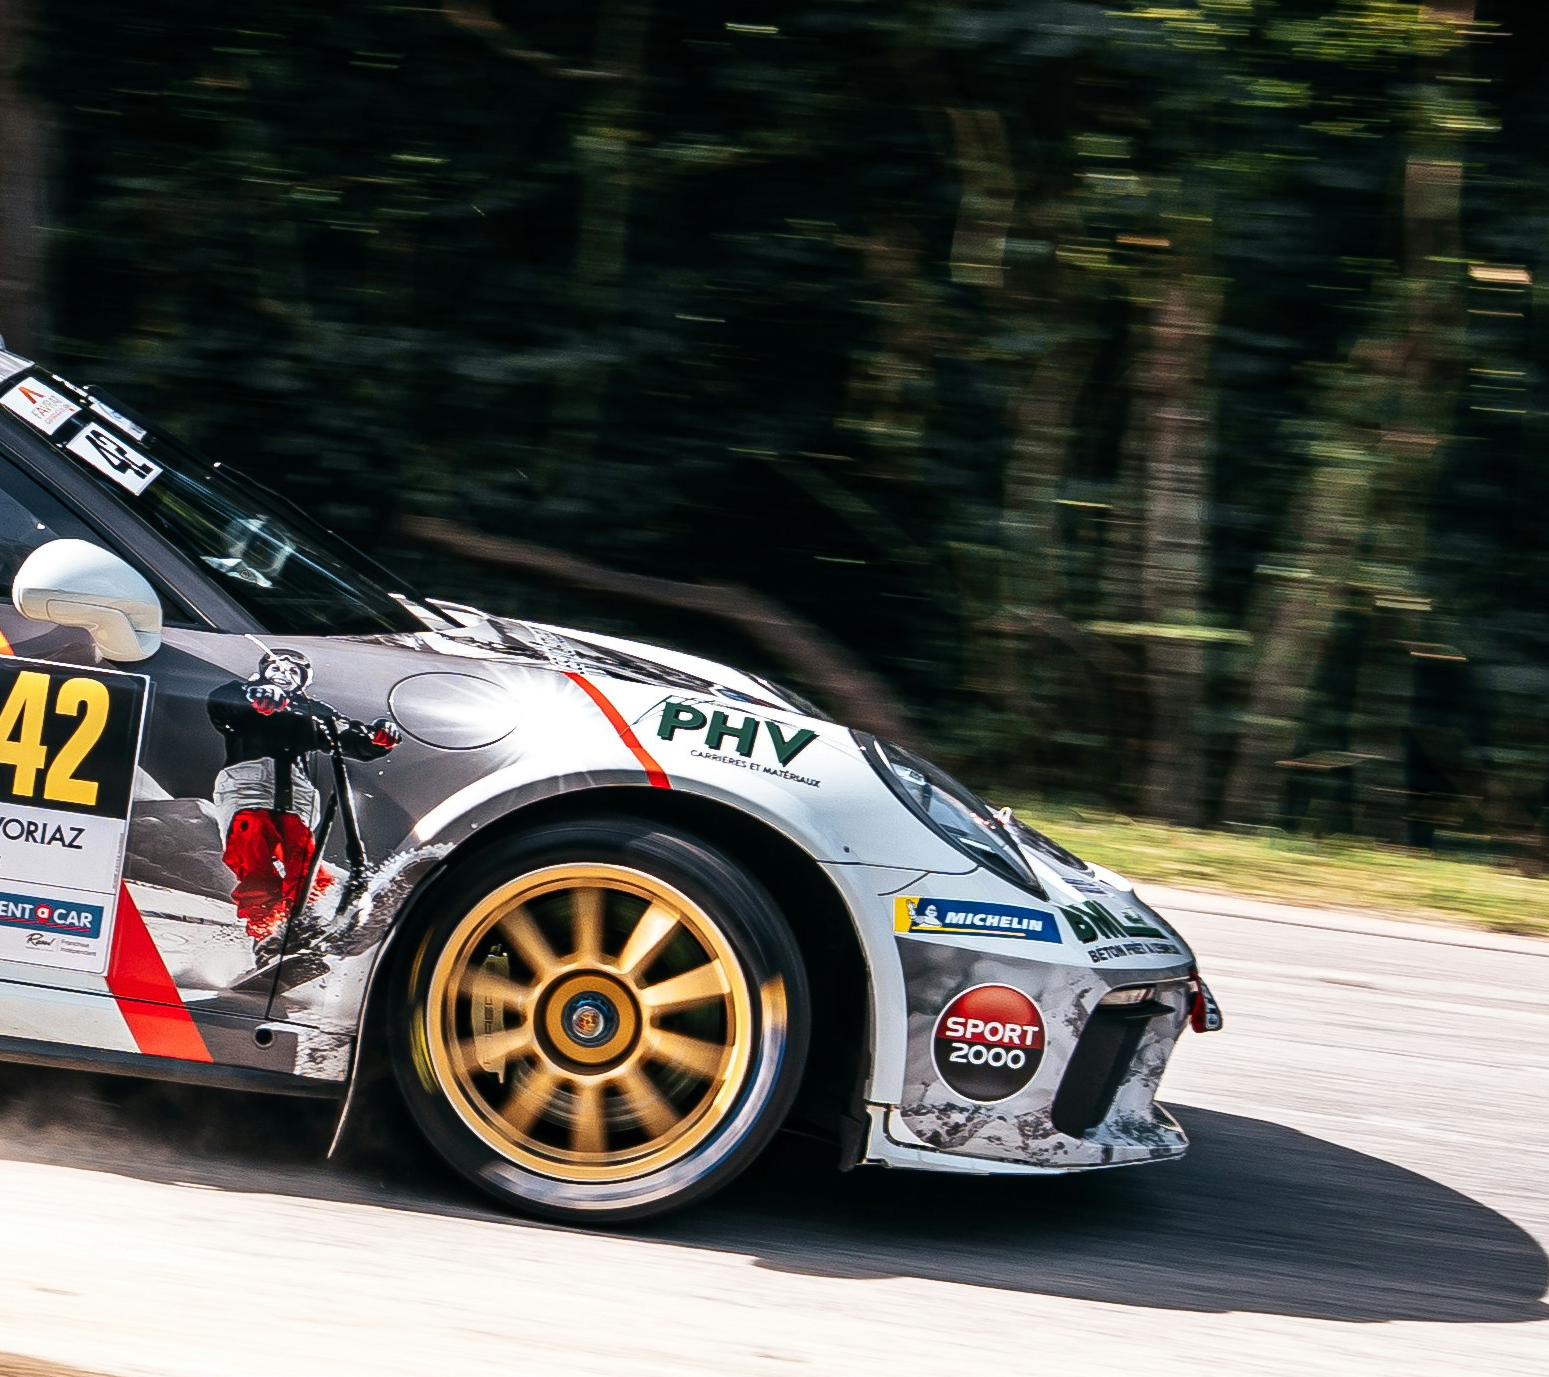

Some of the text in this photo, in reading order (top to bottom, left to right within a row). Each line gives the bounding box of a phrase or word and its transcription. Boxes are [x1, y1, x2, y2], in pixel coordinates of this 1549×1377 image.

[749, 762, 761, 771] ET
[52, 908, 93, 928] CAR
[944, 911, 1043, 932] MICHELIN
[945, 1015, 1040, 1047] SPORT
[948, 1042, 1027, 1070] 2000
